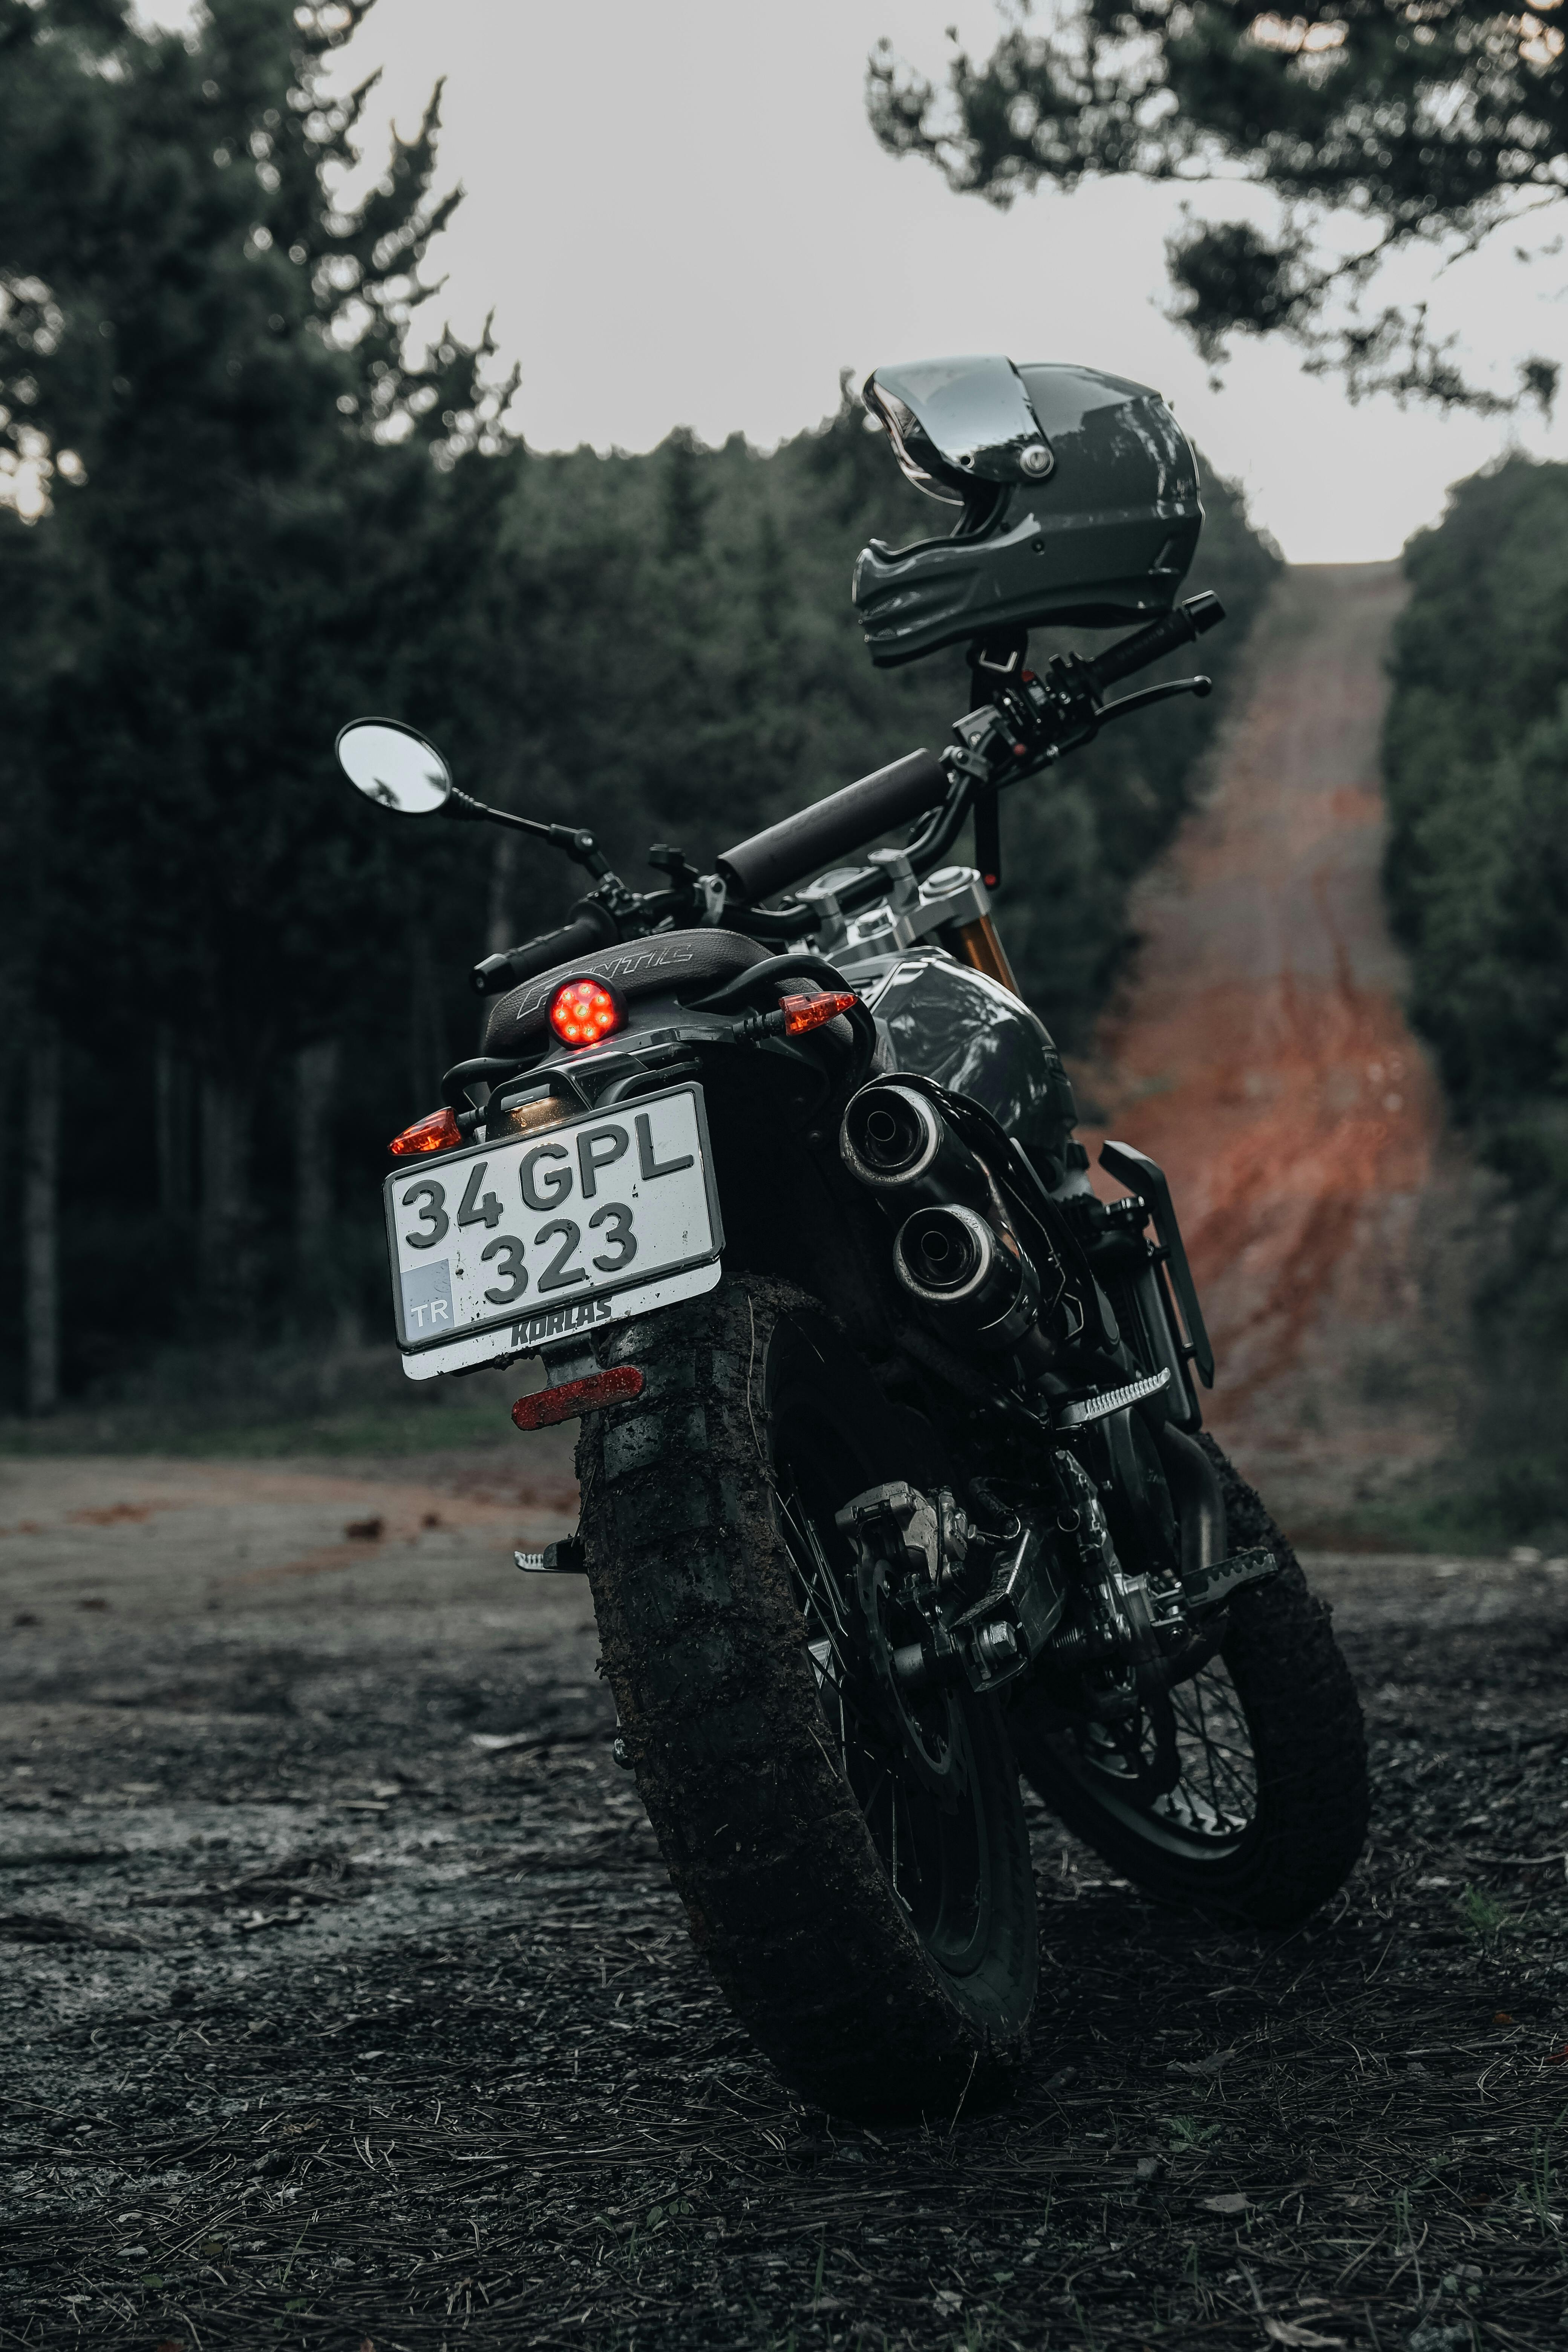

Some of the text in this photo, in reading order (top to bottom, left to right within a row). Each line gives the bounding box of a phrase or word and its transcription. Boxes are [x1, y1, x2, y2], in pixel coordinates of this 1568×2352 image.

[517, 945, 694, 1020] FNTIC
[402, 1113, 694, 1249] 34 GPL
[481, 1202, 637, 1305] 323
[411, 1299, 449, 1328] TR
[511, 1298, 612, 1347] KORLAS
